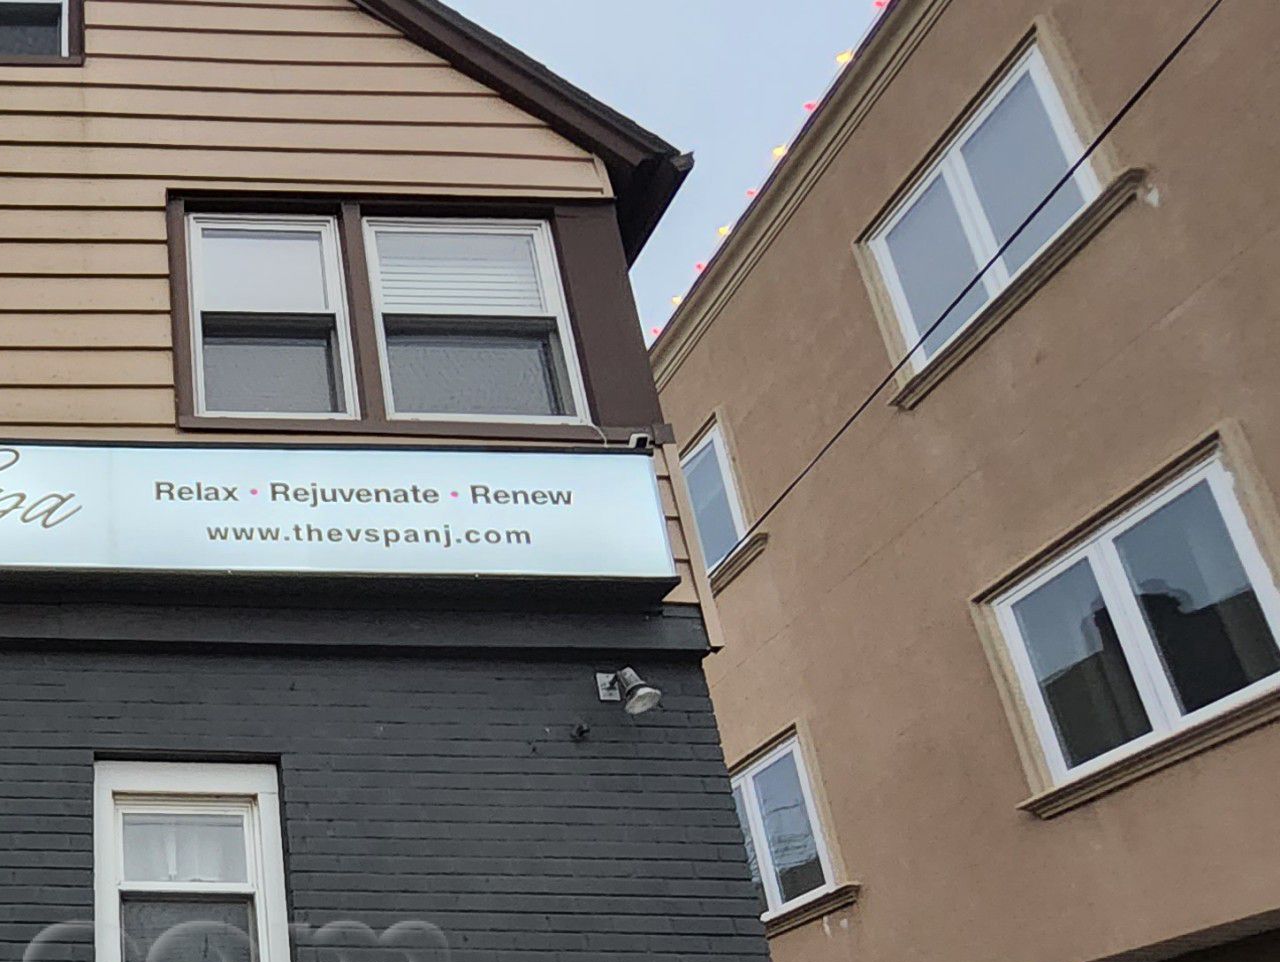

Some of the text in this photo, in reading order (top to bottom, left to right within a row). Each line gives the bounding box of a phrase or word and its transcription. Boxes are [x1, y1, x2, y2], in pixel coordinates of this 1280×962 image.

[154, 481, 574, 508] Relax Rejuvenate Renew
[206, 522, 532, 548] www.thevspanj.com
